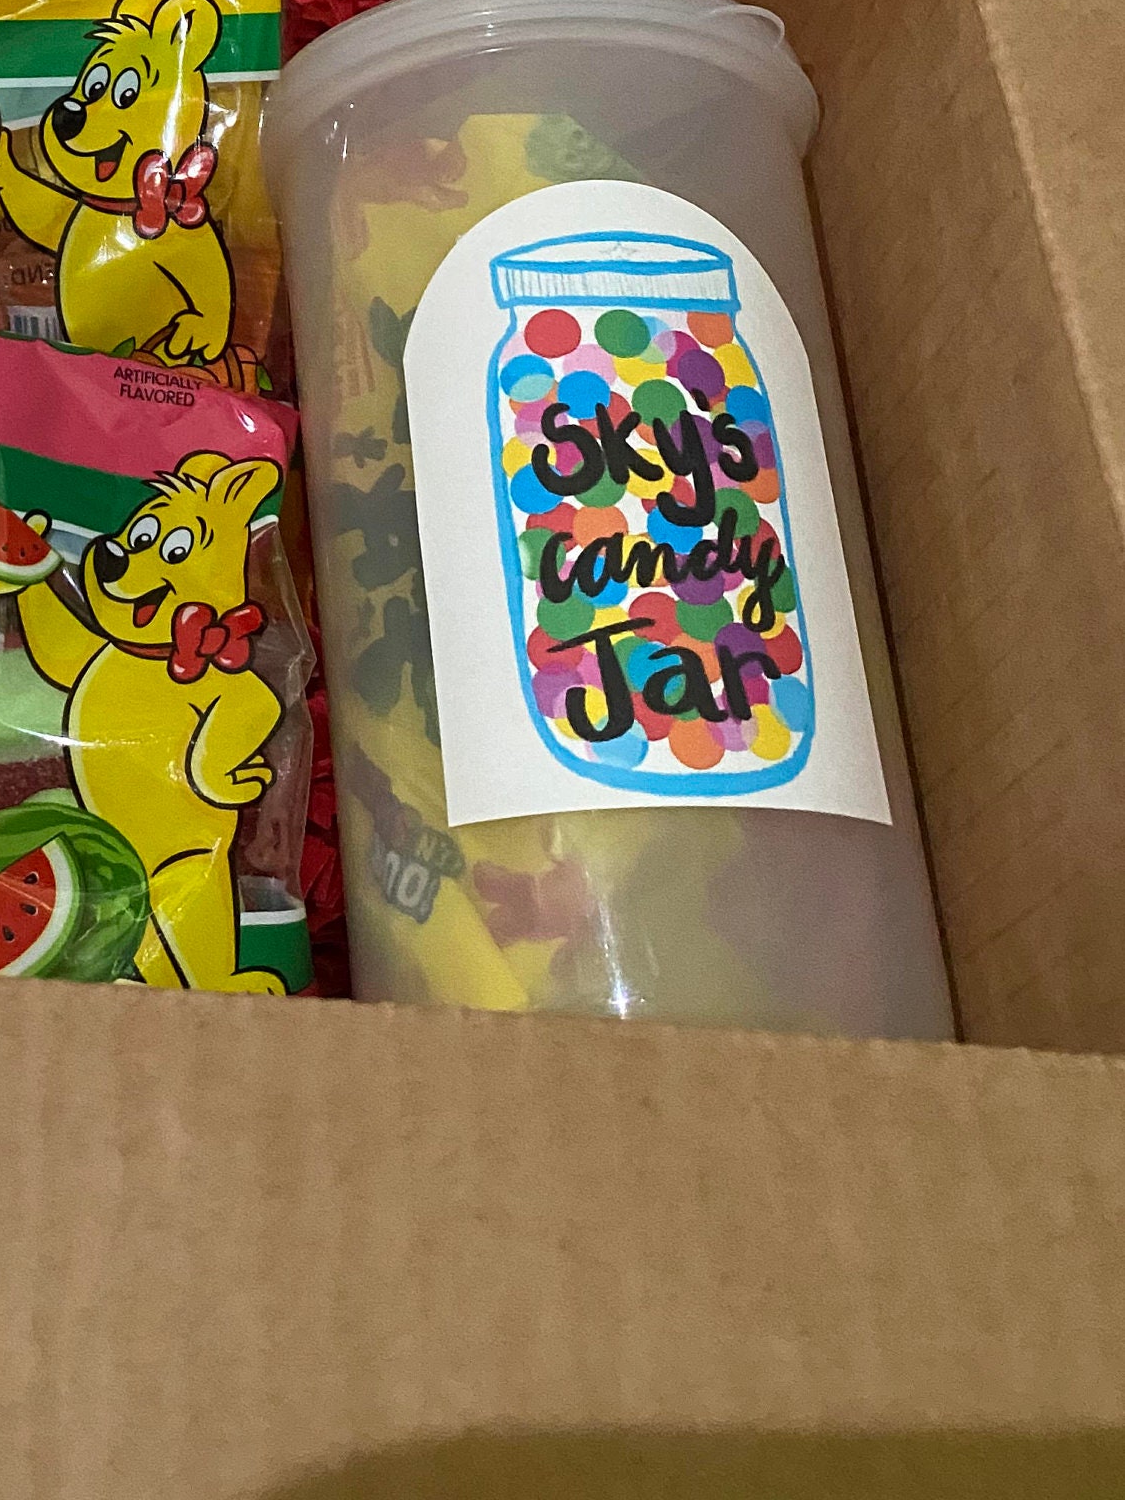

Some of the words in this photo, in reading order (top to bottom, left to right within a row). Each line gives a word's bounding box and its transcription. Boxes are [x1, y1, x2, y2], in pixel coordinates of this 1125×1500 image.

[114, 366, 203, 390] ARTIFICIALLY
[120, 383, 195, 407] FLAVORED
[531, 388, 760, 528] Sky's
[540, 506, 787, 633] candy
[546, 616, 783, 743] Jar
